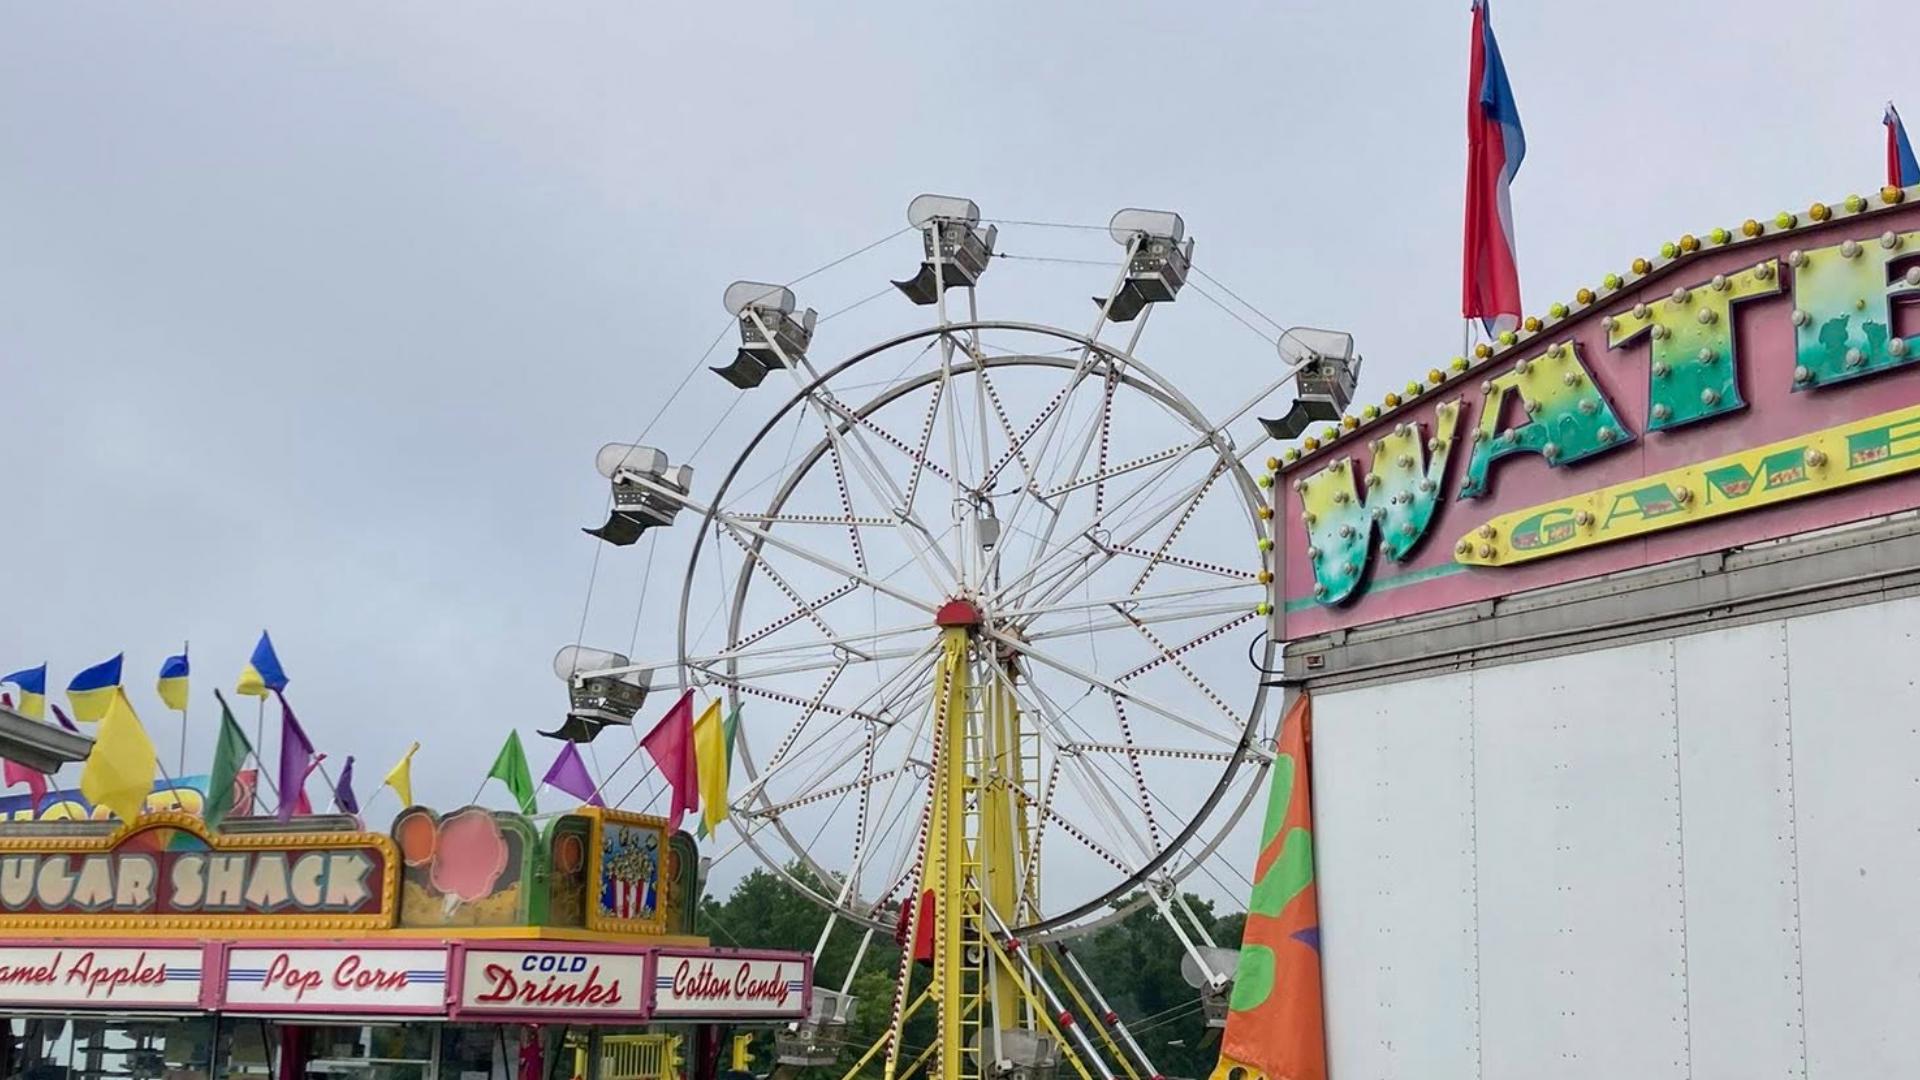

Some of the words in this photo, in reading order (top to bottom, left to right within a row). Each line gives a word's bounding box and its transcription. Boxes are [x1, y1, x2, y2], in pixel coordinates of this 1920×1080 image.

[1297, 230, 1920, 608] WATE
[1510, 417, 1920, 551] GAME
[0, 854, 157, 912] UGAR
[170, 851, 376, 912] SHACK
[65, 952, 168, 998] Apples
[262, 953, 325, 999] Pop
[335, 955, 410, 988] Corn
[475, 963, 622, 1005] Drinks
[522, 955, 588, 973] COLD
[672, 960, 733, 1000] Cotton
[735, 963, 789, 1007] Candy
